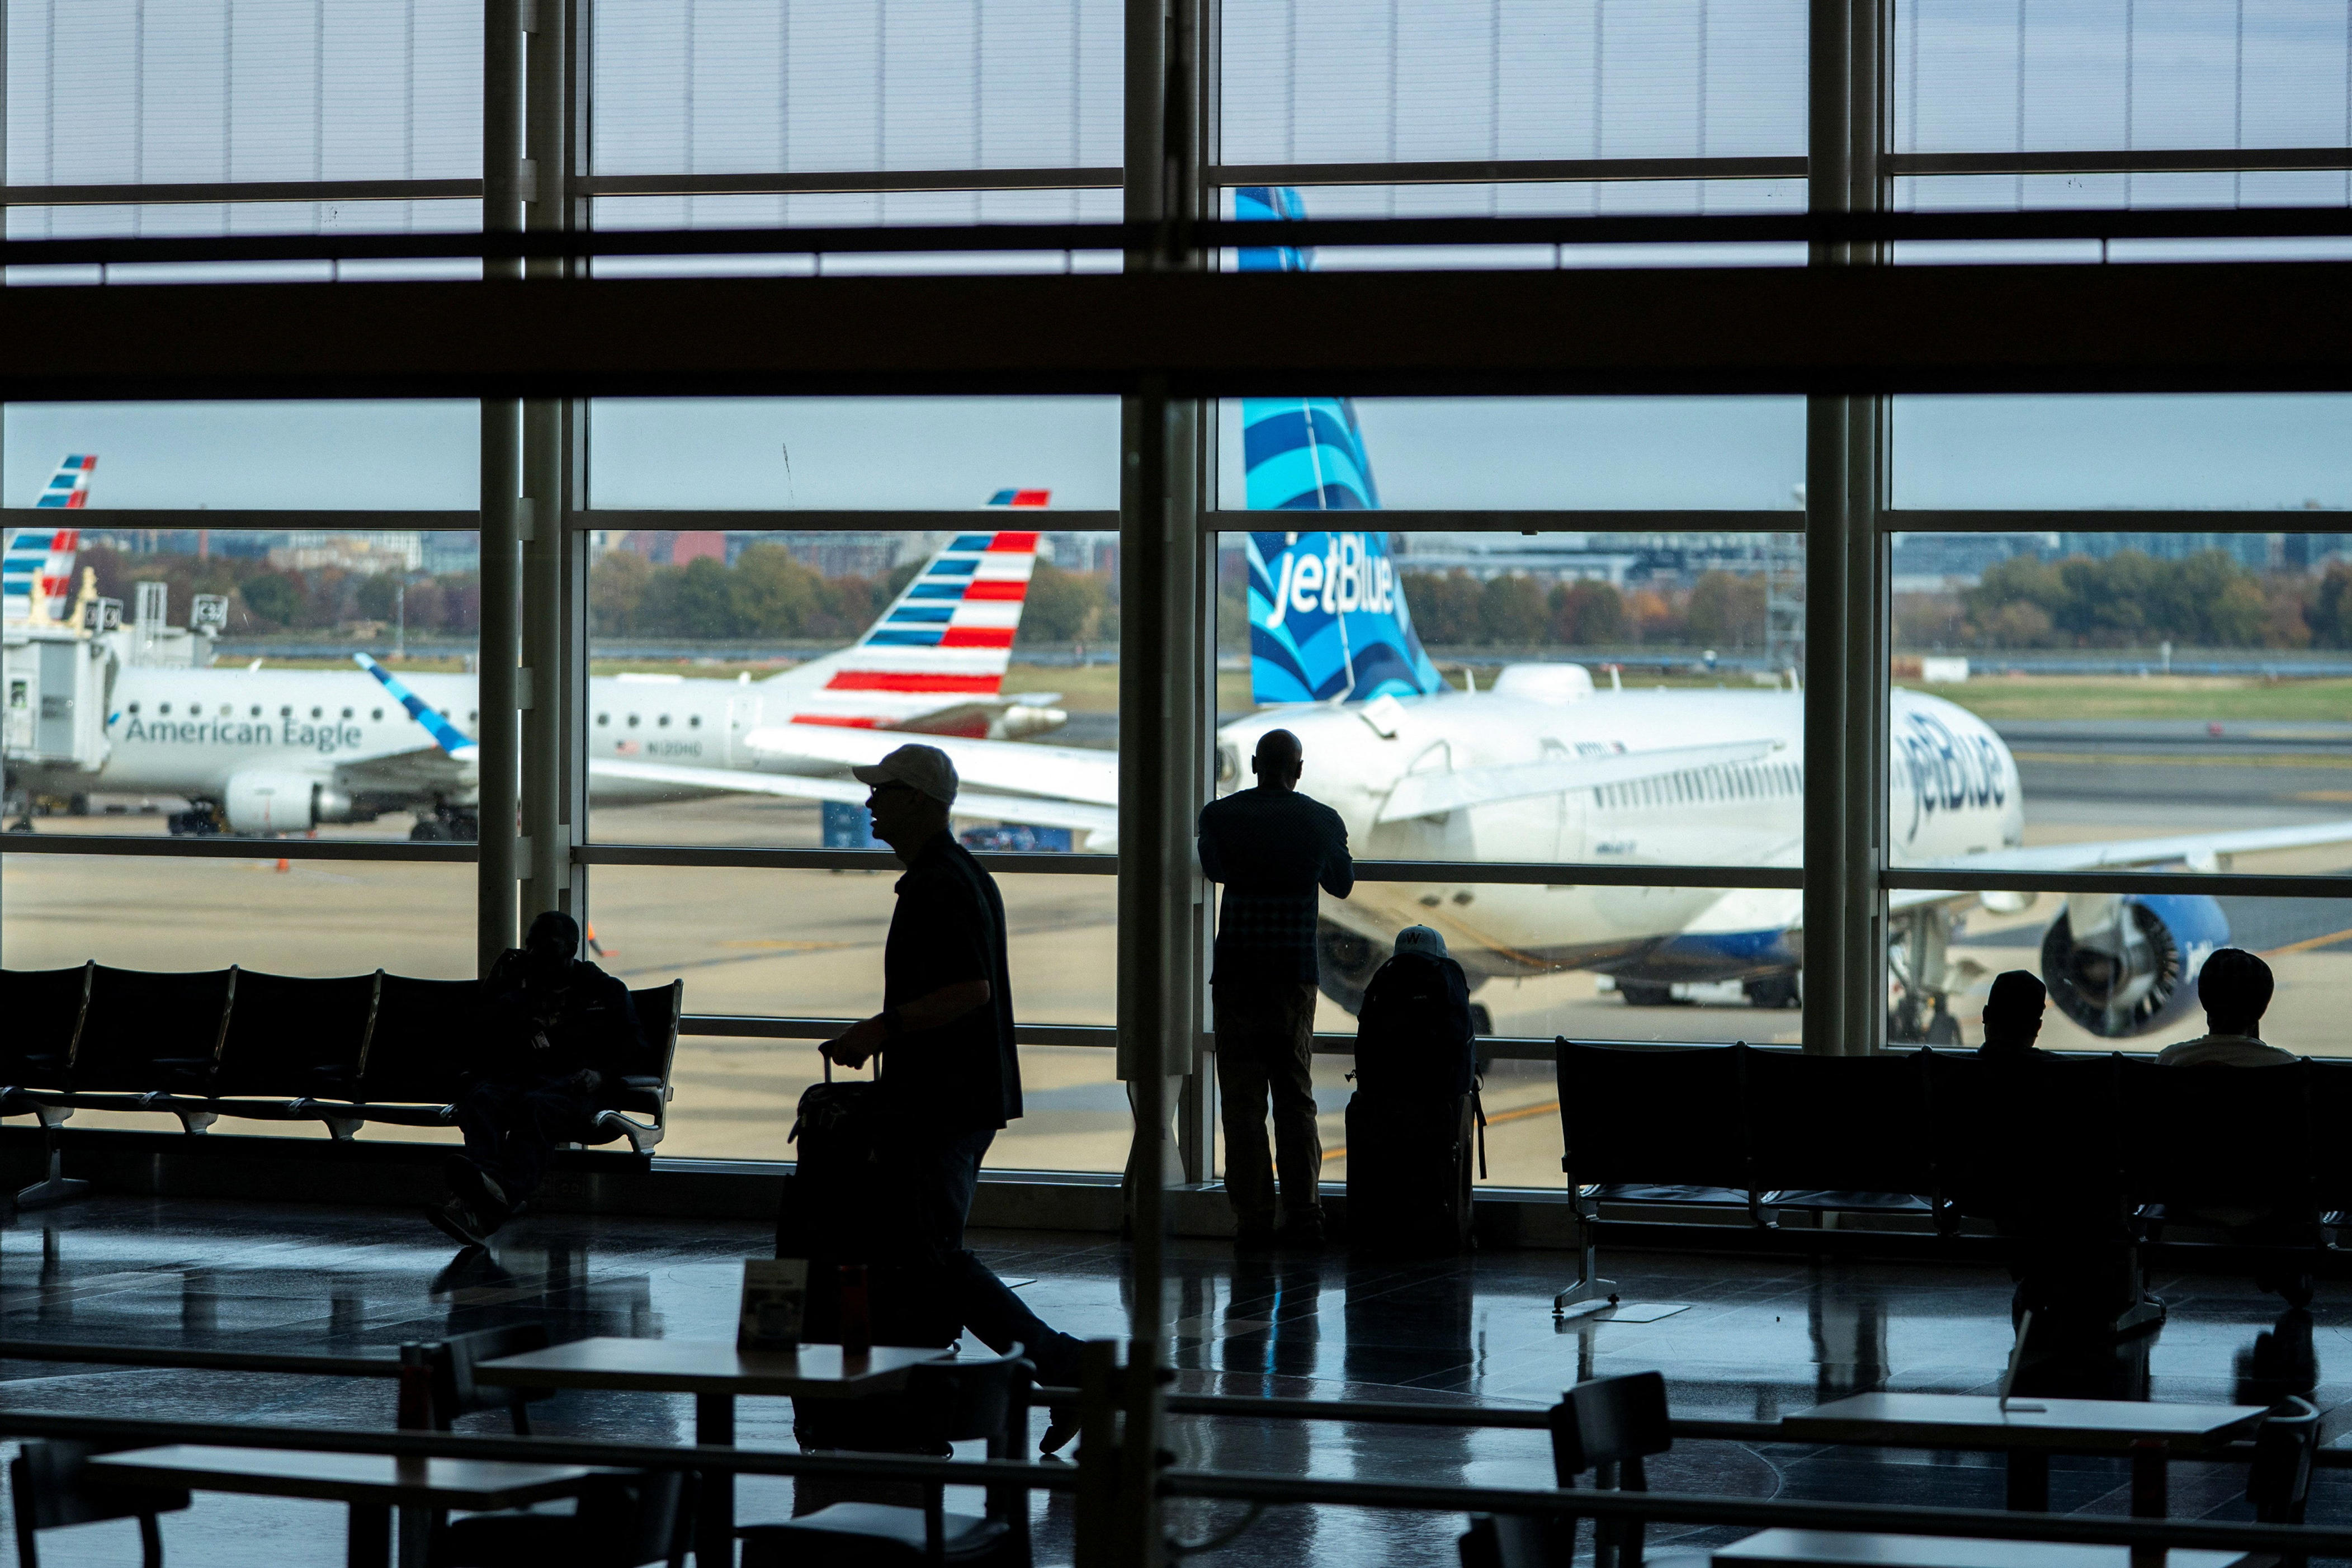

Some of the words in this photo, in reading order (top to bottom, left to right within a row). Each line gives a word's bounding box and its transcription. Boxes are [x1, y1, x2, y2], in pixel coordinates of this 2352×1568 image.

[1267, 532, 1395, 629] jetBlue
[126, 717, 272, 743] American
[282, 718, 362, 753] Eagle
[1406, 932, 1421, 944] W
